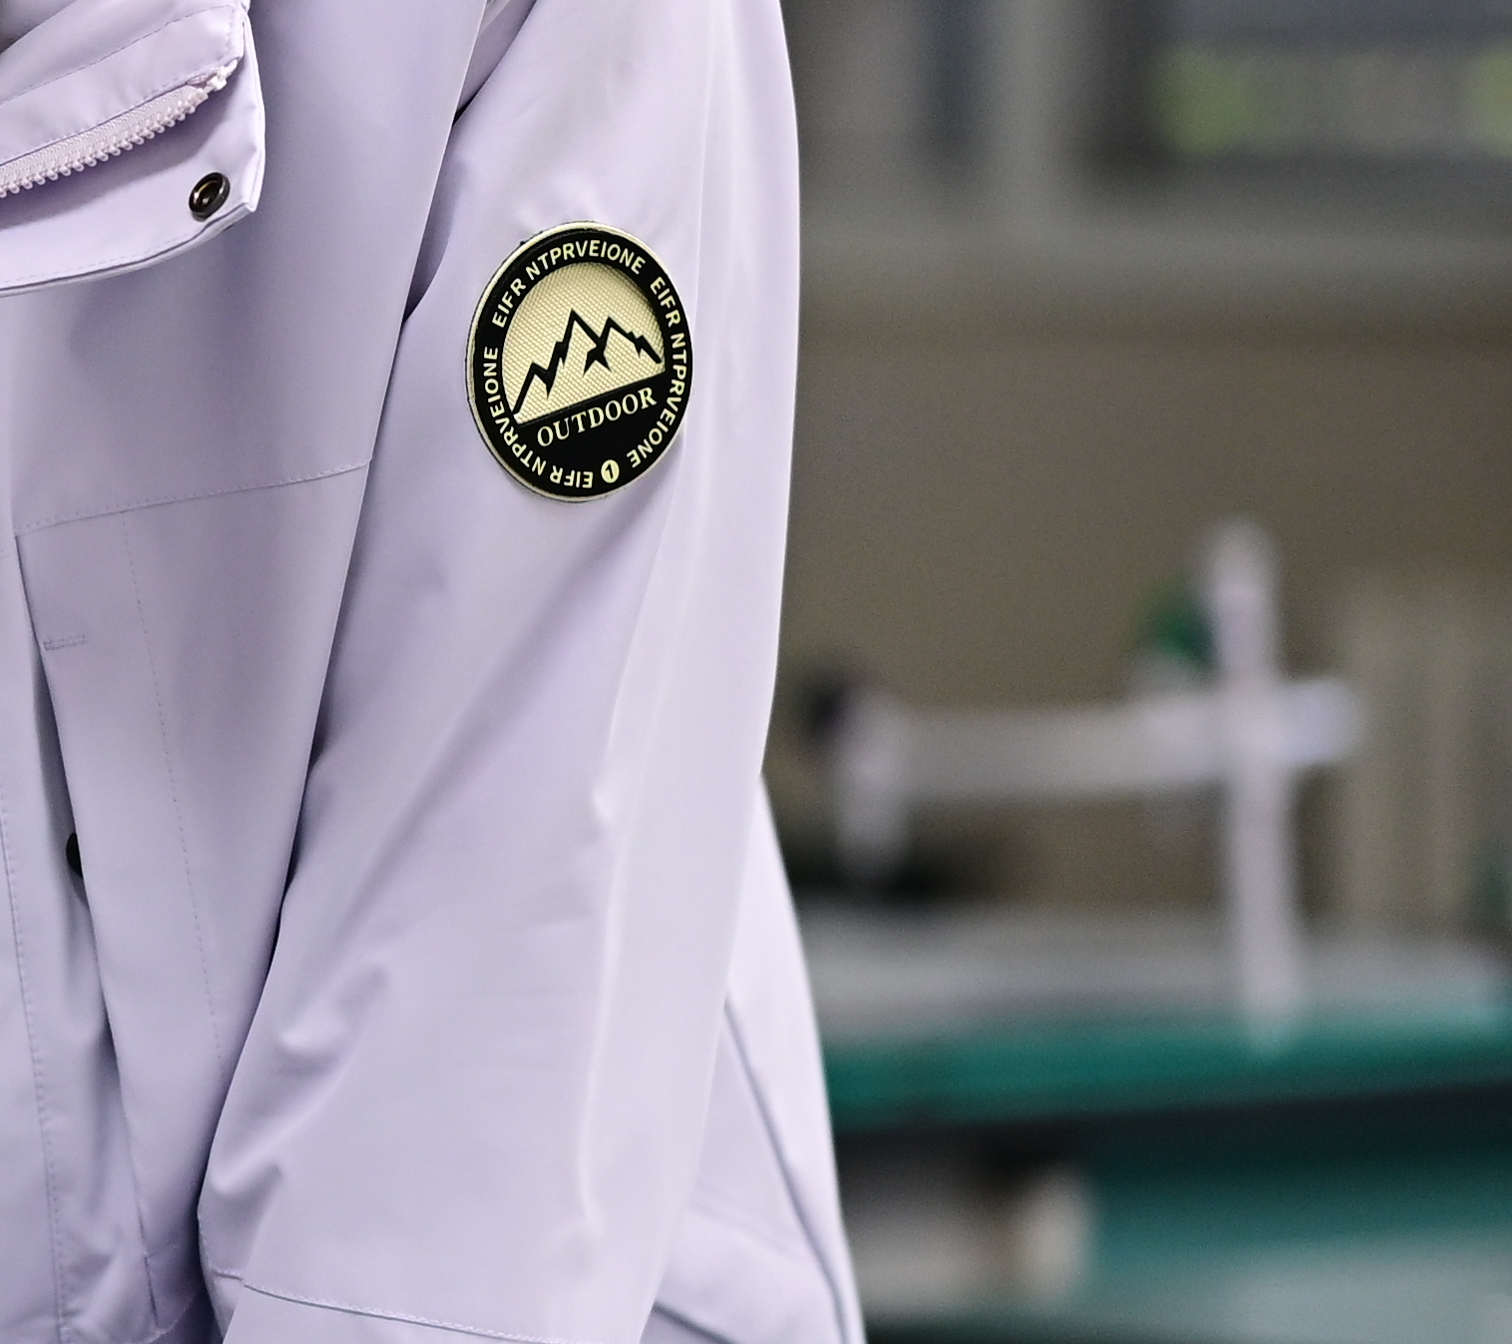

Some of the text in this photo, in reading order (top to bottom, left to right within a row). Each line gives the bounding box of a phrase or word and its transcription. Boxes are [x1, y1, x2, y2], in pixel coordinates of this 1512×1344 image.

[492, 238, 647, 329] EIFR NTPRVEIONE
[482, 345, 594, 490] EIFR NTPRVEIONE
[536, 385, 658, 448] OUTDOOR
[626, 276, 687, 470] EIFR NTPRVEIONE
